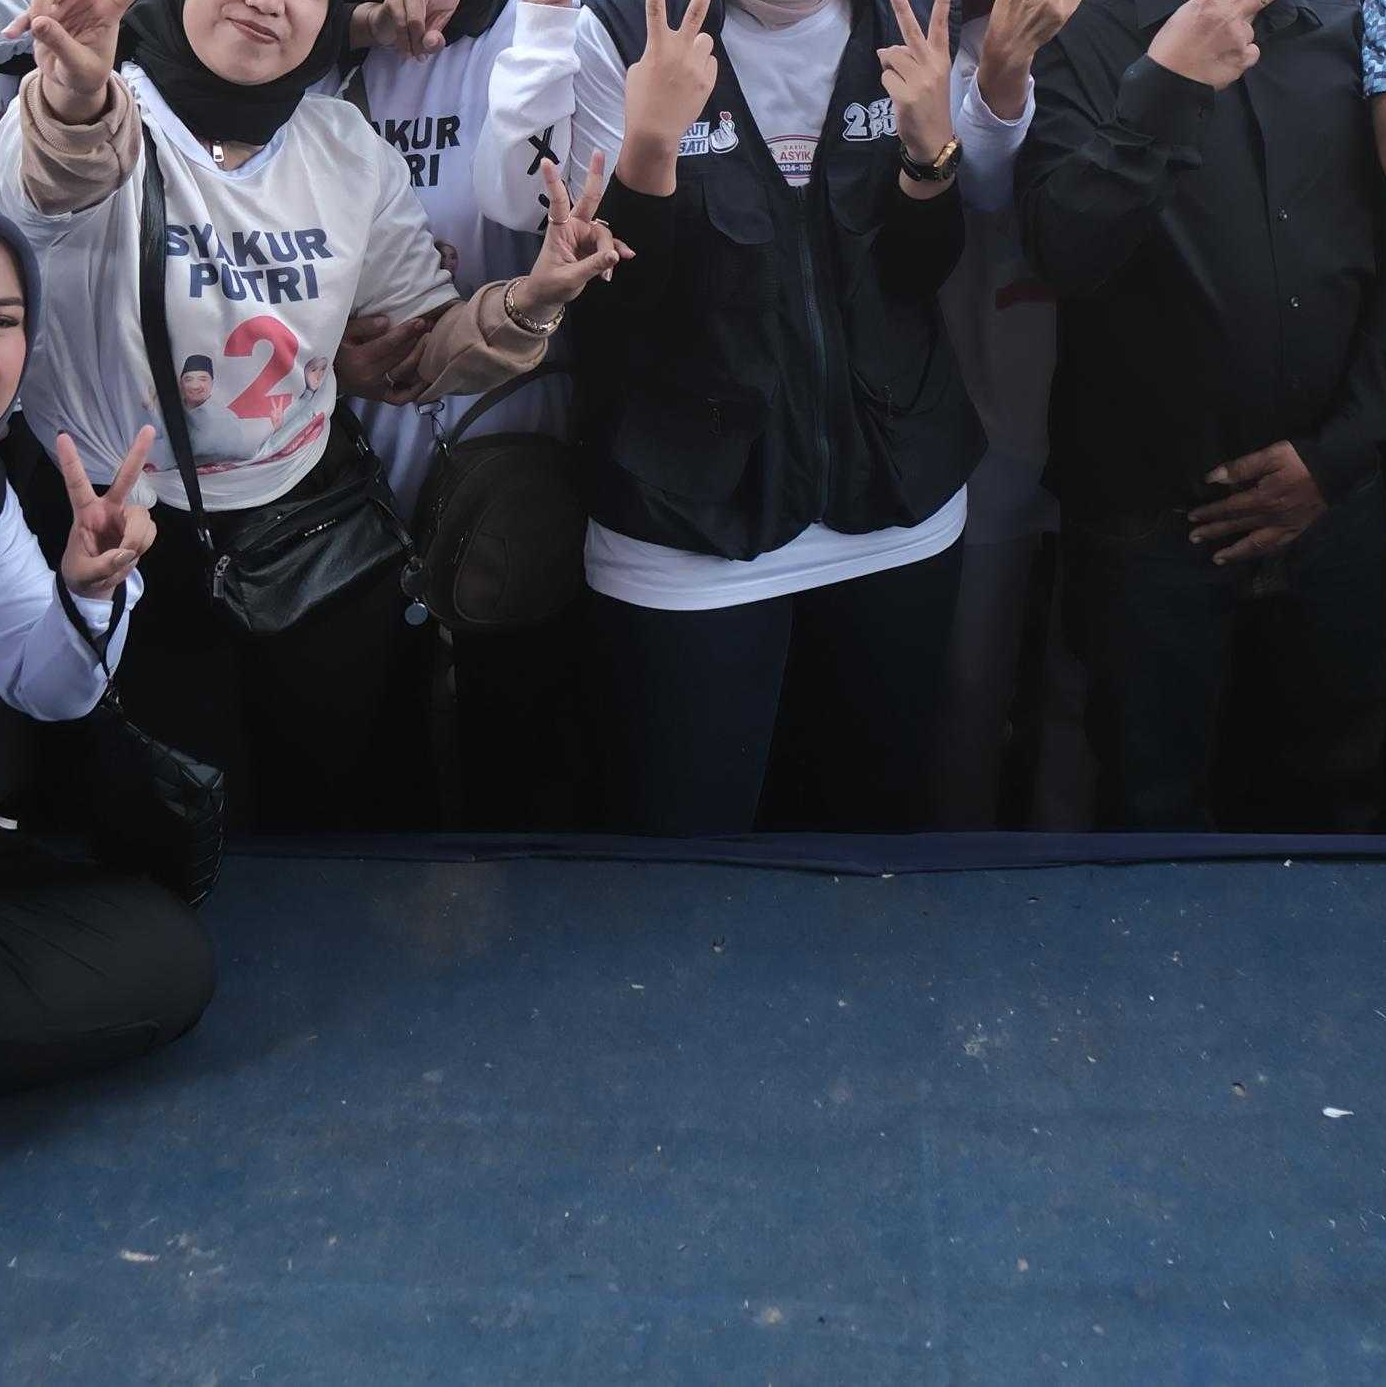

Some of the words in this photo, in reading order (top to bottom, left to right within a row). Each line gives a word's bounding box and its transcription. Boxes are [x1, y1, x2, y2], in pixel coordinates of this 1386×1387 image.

[780, 150, 812, 162] ASYIK
[189, 262, 320, 305] PUTRI
[223, 315, 300, 420] 2
